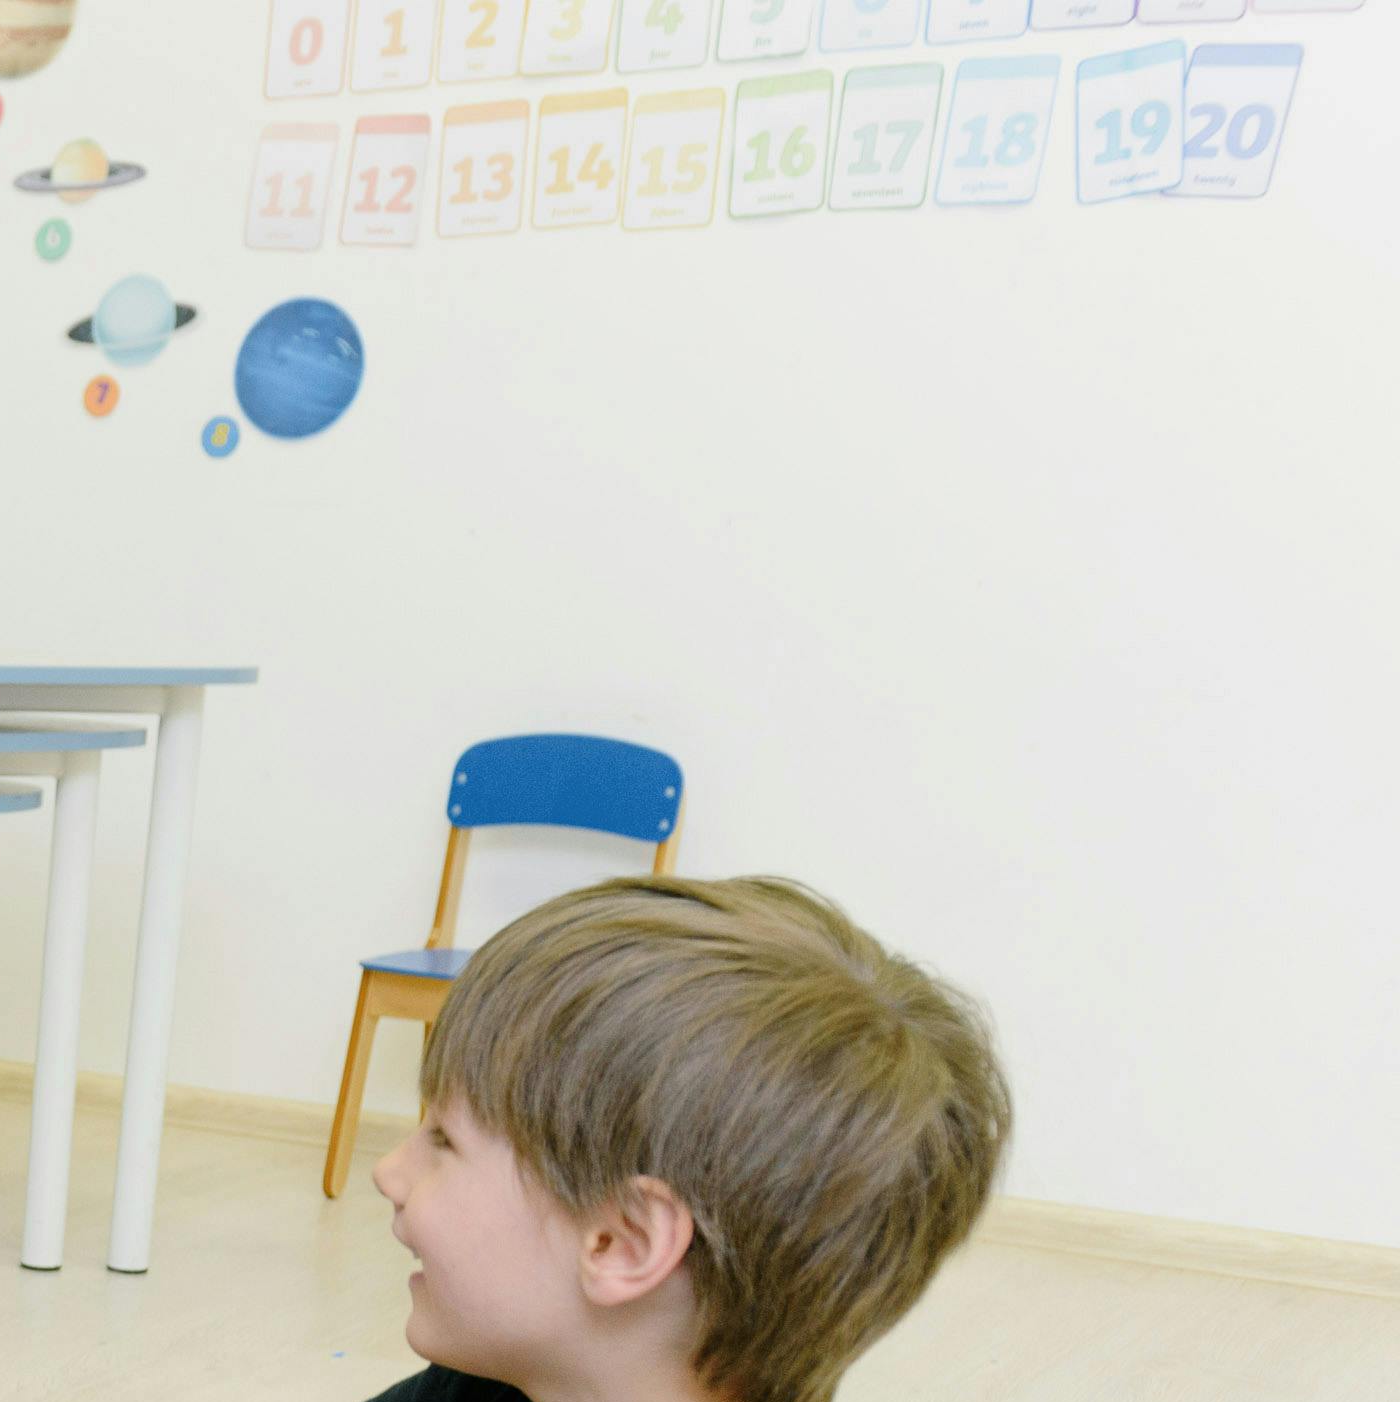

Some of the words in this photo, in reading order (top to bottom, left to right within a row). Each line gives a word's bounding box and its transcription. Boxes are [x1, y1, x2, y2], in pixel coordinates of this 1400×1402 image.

[290, 18, 324, 65] 0
[379, 9, 409, 58] 1
[464, 0, 499, 49] 2
[548, 0, 586, 41] 3
[643, 0, 685, 35] 4
[743, 124, 818, 183] 16
[847, 119, 925, 176] 17
[954, 112, 1038, 167] 18
[1095, 101, 1171, 164] 19
[1183, 102, 1278, 160] 20
[353, 164, 418, 214] 12
[448, 152, 515, 205] 13
[544, 142, 616, 196] 14
[636, 143, 708, 197] 15
[1193, 173, 1239, 188] twenty
[260, 172, 314, 217] 11
[94, 381, 110, 405] 7
[211, 422, 229, 447] 8
